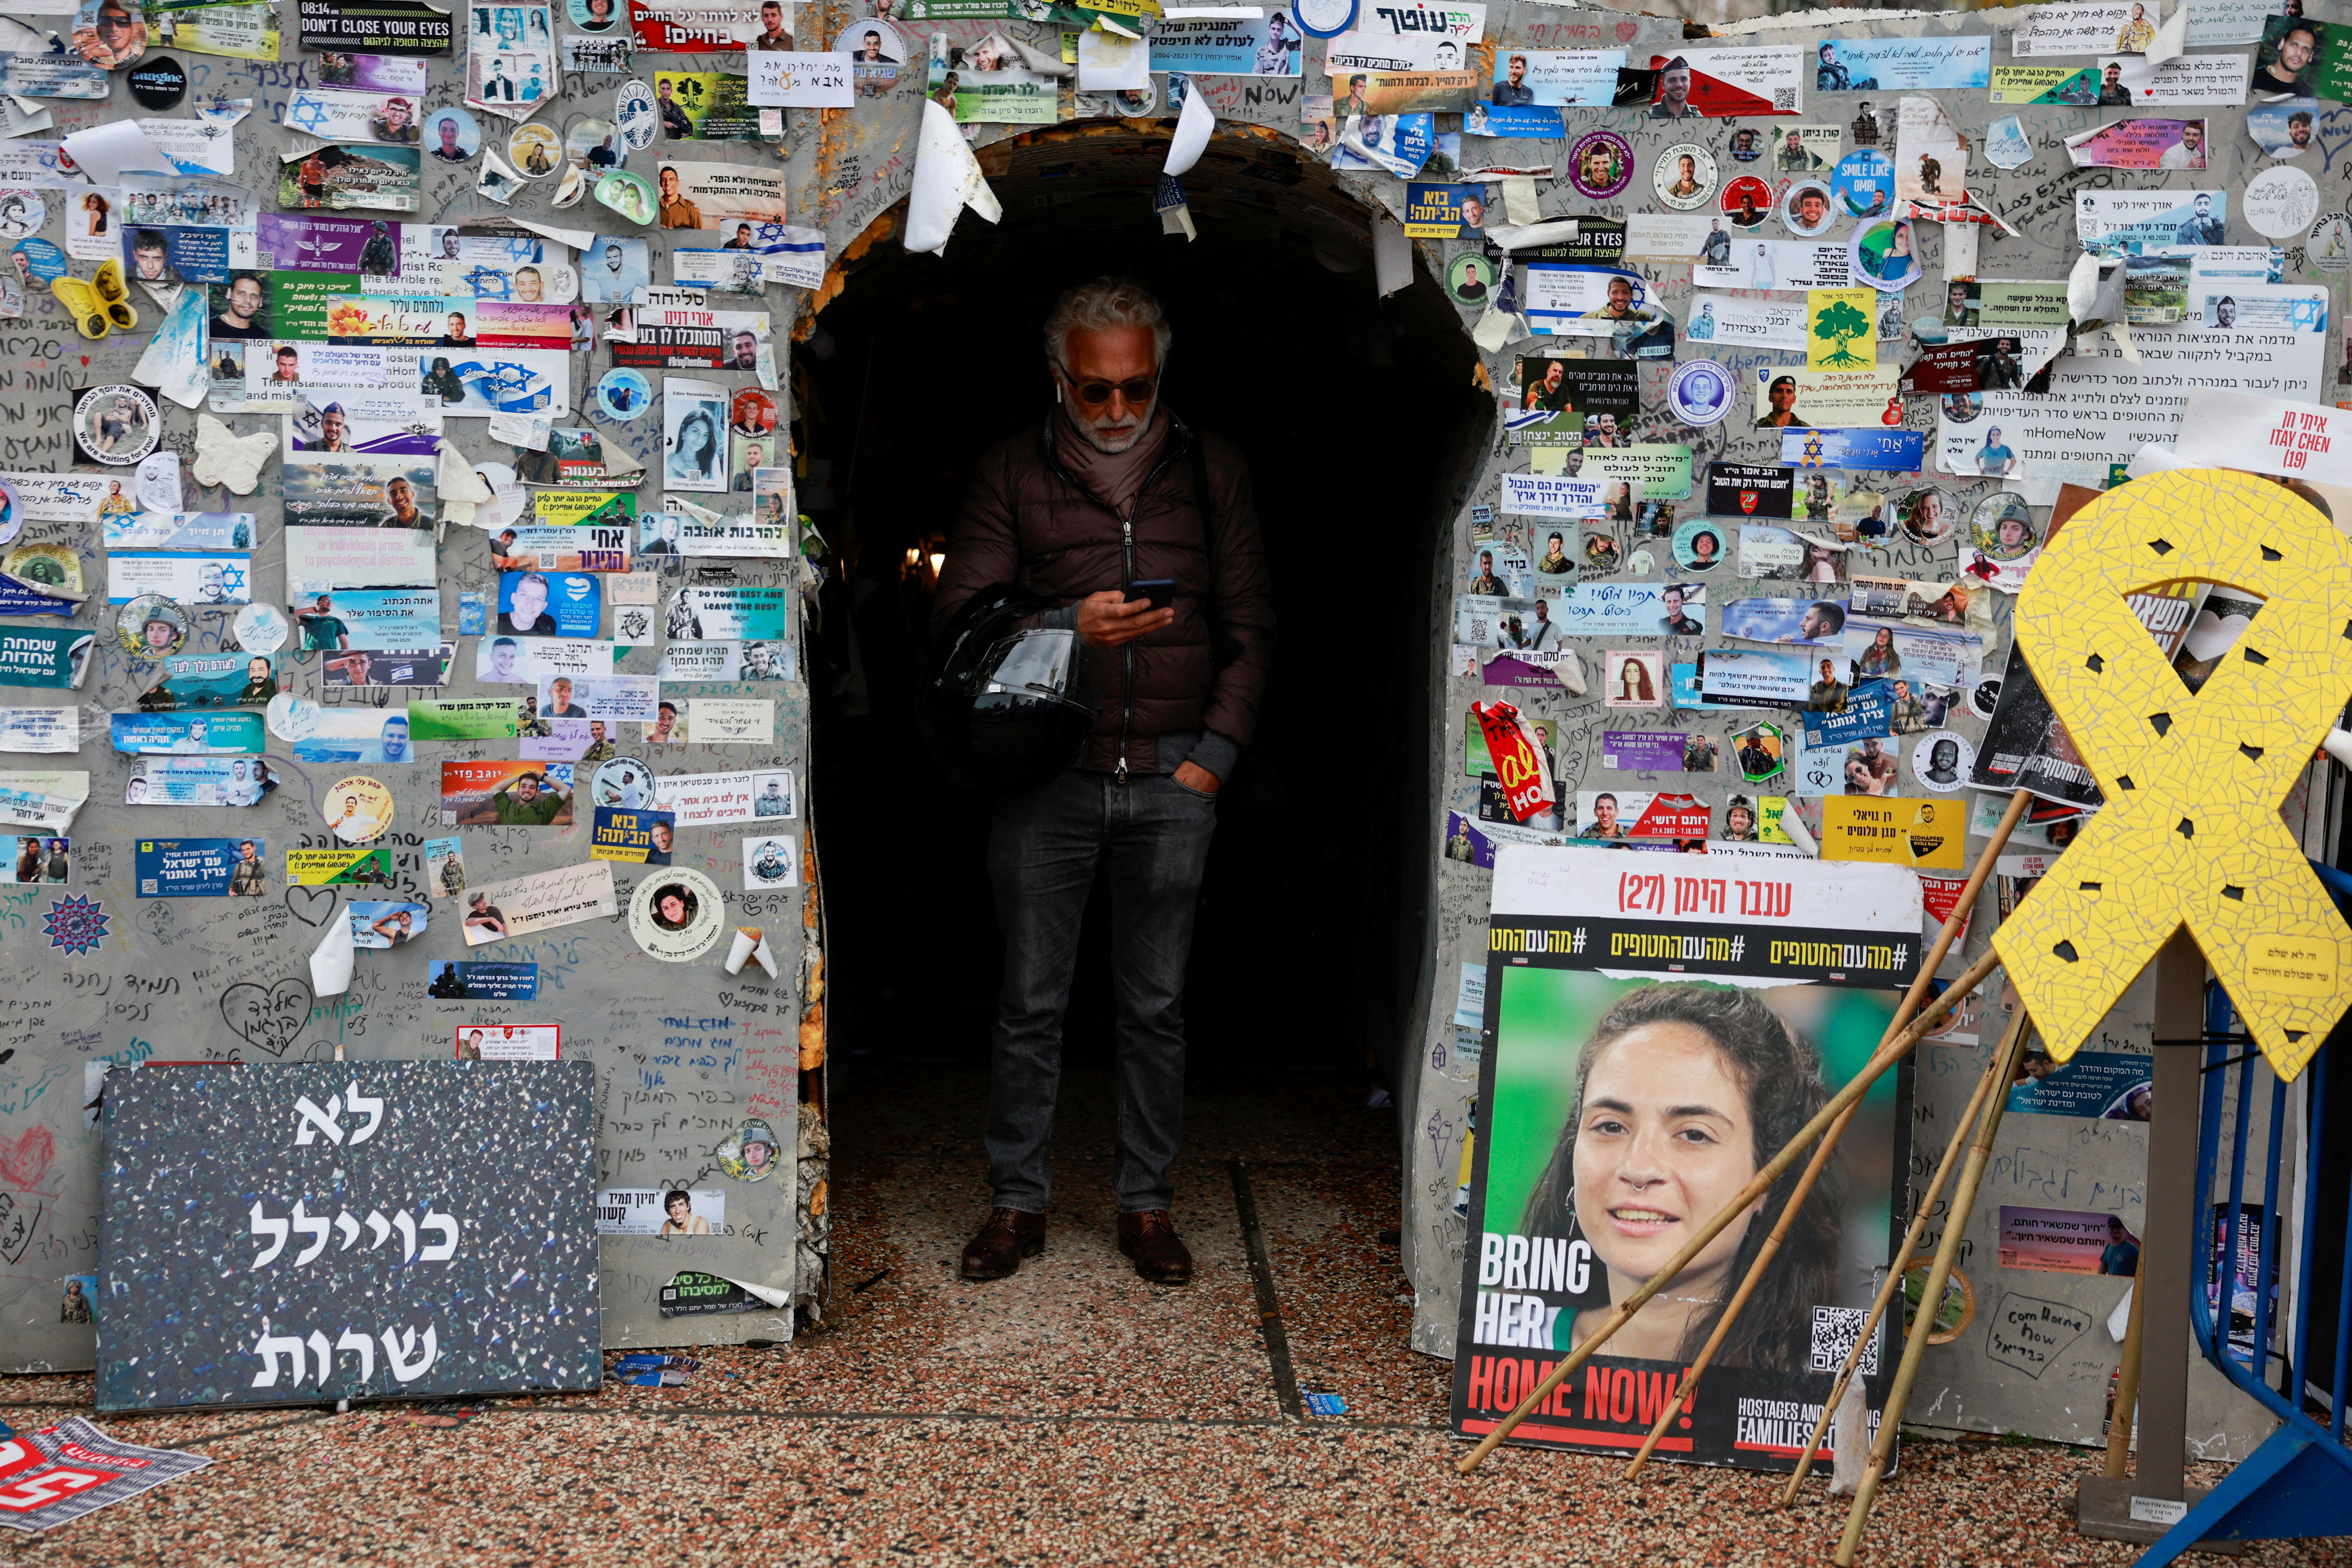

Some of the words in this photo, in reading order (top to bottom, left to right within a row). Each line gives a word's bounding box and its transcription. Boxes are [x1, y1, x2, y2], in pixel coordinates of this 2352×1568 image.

[302, 2, 330, 14] 08:14
[634, 10, 673, 23] החיים
[681, 12, 692, 21] על
[702, 12, 735, 21] לוותר
[744, 12, 757, 21] לא
[1376, 6, 1447, 34] עוטף
[1448, 12, 1470, 22] הלב
[302, 18, 337, 32] DON'T
[342, 20, 380, 34] CLOSE
[384, 21, 415, 35] YOUR
[420, 22, 449, 35] EYES
[363, 36, 391, 45] לגיהנום
[665, 25, 734, 44] בחיים!
[1194, 34, 1212, 45] לא
[1216, 34, 1254, 47] לעולם
[394, 38, 418, 46] חטופה
[421, 38, 449, 48] #הצצה
[1150, 37, 1191, 47] תיפסק
[2181, 74, 2192, 83] על
[2219, 75, 2242, 84] החיוך
[1409, 127, 1424, 137] גלי
[1405, 136, 1427, 147] ברמן
[1842, 164, 1867, 176] SMILE
[1871, 164, 1890, 176] LIKE
[1854, 180, 1876, 192] OMRI
[1423, 190, 1450, 206] בוא
[2112, 201, 2128, 210] לעד
[2152, 202, 2172, 211] אורך
[1409, 205, 1462, 222] הביתה!
[649, 290, 705, 306] סליחה
[665, 311, 688, 325] דנינו
[692, 312, 713, 326] אורי
[2282, 412, 2296, 428] חן
[2301, 413, 2327, 433] איתי
[1524, 431, 1550, 443] ינצח!
[1554, 432, 1581, 440] הטוב
[2270, 429, 2297, 451] ITAY
[2298, 433, 2330, 453] CHEN
[79, 431, 88, 444] We
[86, 445, 99, 455] are
[100, 453, 130, 463] waiting
[131, 451, 143, 460] for
[142, 436, 155, 453] you!
[2283, 451, 2307, 470] (19)
[1762, 467, 1779, 476] רגב
[1509, 477, 1534, 489] הגבול
[1537, 481, 1551, 490] הם
[1555, 483, 1600, 493] "השמיים
[1514, 490, 1536, 502] ארץ"
[1539, 493, 1558, 503] דרך
[1562, 494, 1592, 504] והדרך
[684, 526, 725, 537] אהבה
[730, 527, 782, 539] להרבות
[592, 530, 624, 548] אחי
[578, 550, 623, 570] הגיבור
[764, 591, 783, 599] AND
[347, 610, 364, 618] שלך
[4, 637, 56, 651] שמחה
[667, 646, 702, 655] שמחים
[0, 651, 55, 665] אחדות
[671, 657, 698, 666] נחמן!
[1652, 816, 1676, 824] דושי
[1681, 816, 1708, 825] רותם
[163, 858, 200, 868] ישראל
[204, 857, 221, 866] עם
[200, 868, 226, 879] צריך
[1619, 872, 1665, 914] (27)
[1675, 877, 1726, 915] הימן
[1736, 881, 1791, 917] ענבר
[1611, 933, 1745, 961] #מהעםהחטופים
[2268, 947, 2288, 957] שלם
[1770, 941, 1907, 970] #מהעםהחטופים
[2291, 949, 2304, 959] לא
[2253, 967, 2281, 976] חוזרים
[2284, 969, 2313, 980] שכולם
[2317, 973, 2328, 981] עד
[295, 1080, 384, 1145] לא
[2041, 1221, 2079, 1230] שמשאיר
[2081, 1224, 2105, 1232] "חיוך
[250, 1201, 459, 1268] כויילל
[1479, 1232, 1593, 1293] BRING
[1473, 1292, 1547, 1349] HER
[253, 1326, 437, 1387] שרות
[1468, 1356, 1572, 1418] HOME
[1738, 1397, 1798, 1421] HOSTAGES
[1736, 1416, 1813, 1449] FAMILIES
